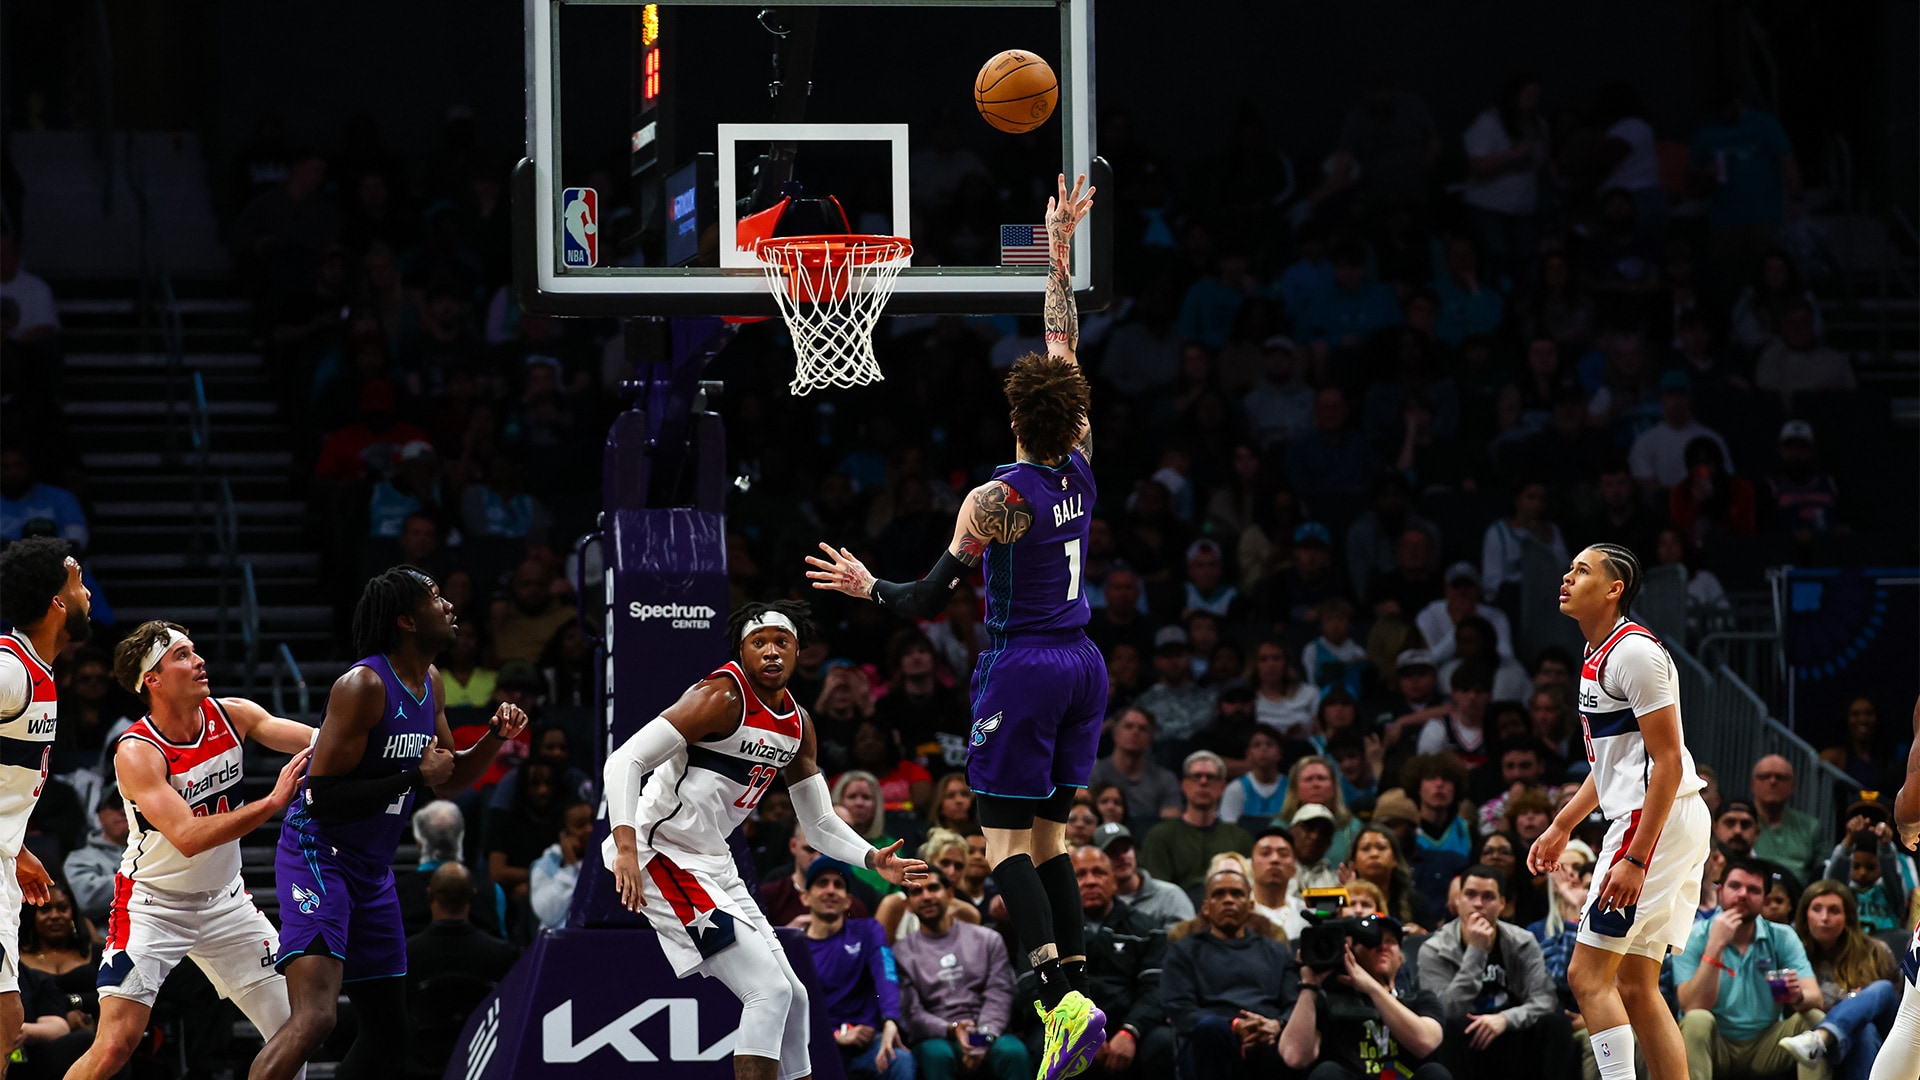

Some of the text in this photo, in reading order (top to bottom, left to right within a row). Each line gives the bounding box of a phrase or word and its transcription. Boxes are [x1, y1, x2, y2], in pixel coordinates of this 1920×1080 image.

[567, 249, 584, 262] NBA
[1052, 492, 1085, 528] BALL
[1063, 538, 1081, 601] 1
[629, 601, 710, 621] Spectrum
[671, 619, 711, 629] CENTER
[382, 732, 433, 759] HORNET
[733, 764, 777, 809] 22
